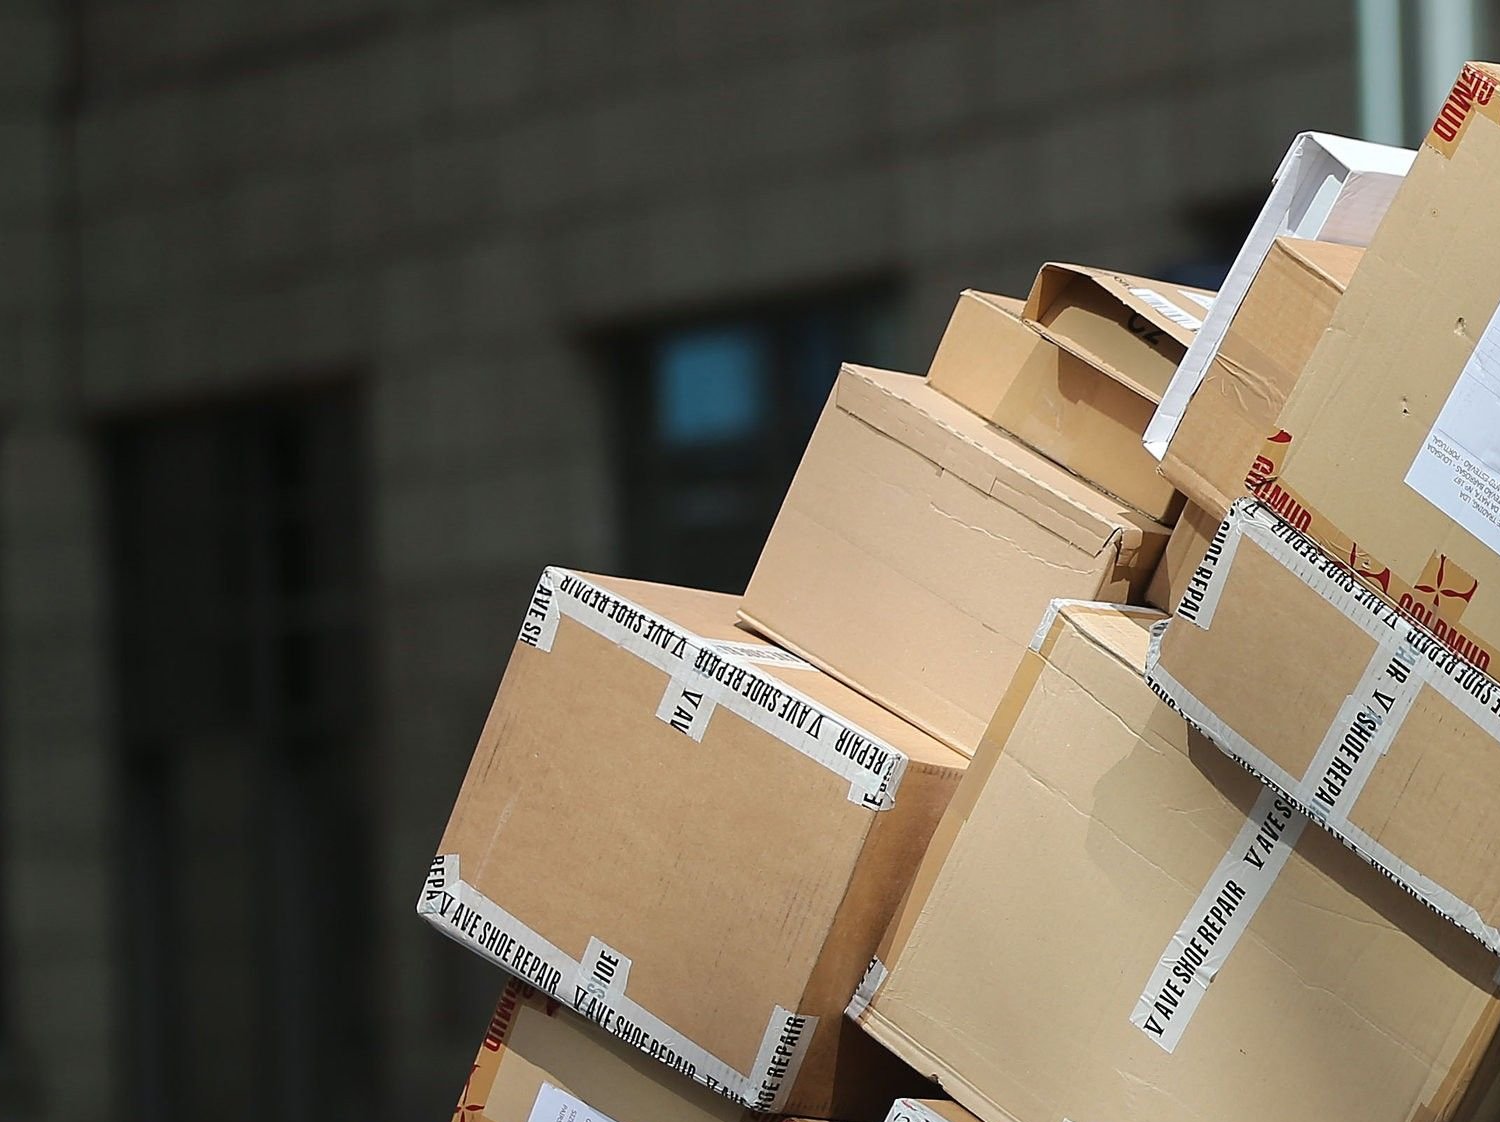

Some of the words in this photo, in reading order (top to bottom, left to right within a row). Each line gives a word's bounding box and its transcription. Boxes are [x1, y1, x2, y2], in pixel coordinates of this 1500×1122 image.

[1426, 442, 1452, 465] LOUSADA
[1430, 434, 1460, 460] PORTUGAL
[1453, 475, 1465, 487] 187
[1455, 464, 1484, 490] BARROSAS
[1463, 459, 1489, 482] ESTEVÃO
[1458, 490, 1471, 504] LDA
[1469, 499, 1498, 524] TRADING,
[1472, 488, 1491, 506] MATA,
[1489, 502, 1499, 513] DA
[529, 584, 552, 622] AVE
[560, 576, 611, 614] REPAIR
[608, 600, 649, 633] SHOE
[1396, 593, 1491, 673] GOLDMUD
[643, 620, 676, 649] AVE
[694, 648, 747, 692] REPAIR
[1454, 666, 1500, 705] SHOE
[742, 673, 782, 712] SHOE
[778, 695, 813, 728] AVE
[835, 728, 889, 776] REPAIR
[1339, 711, 1377, 764] SHOE
[1256, 812, 1286, 855] AVE
[450, 902, 482, 938] AVE
[478, 921, 516, 962] SHOE
[511, 945, 562, 995] REPAIR
[1159, 977, 1185, 1020] AVE
[1172, 935, 1207, 984] SHOE
[1197, 879, 1246, 946] REPAIR
[585, 997, 615, 1031] AVE
[768, 1016, 806, 1078] REPAIR
